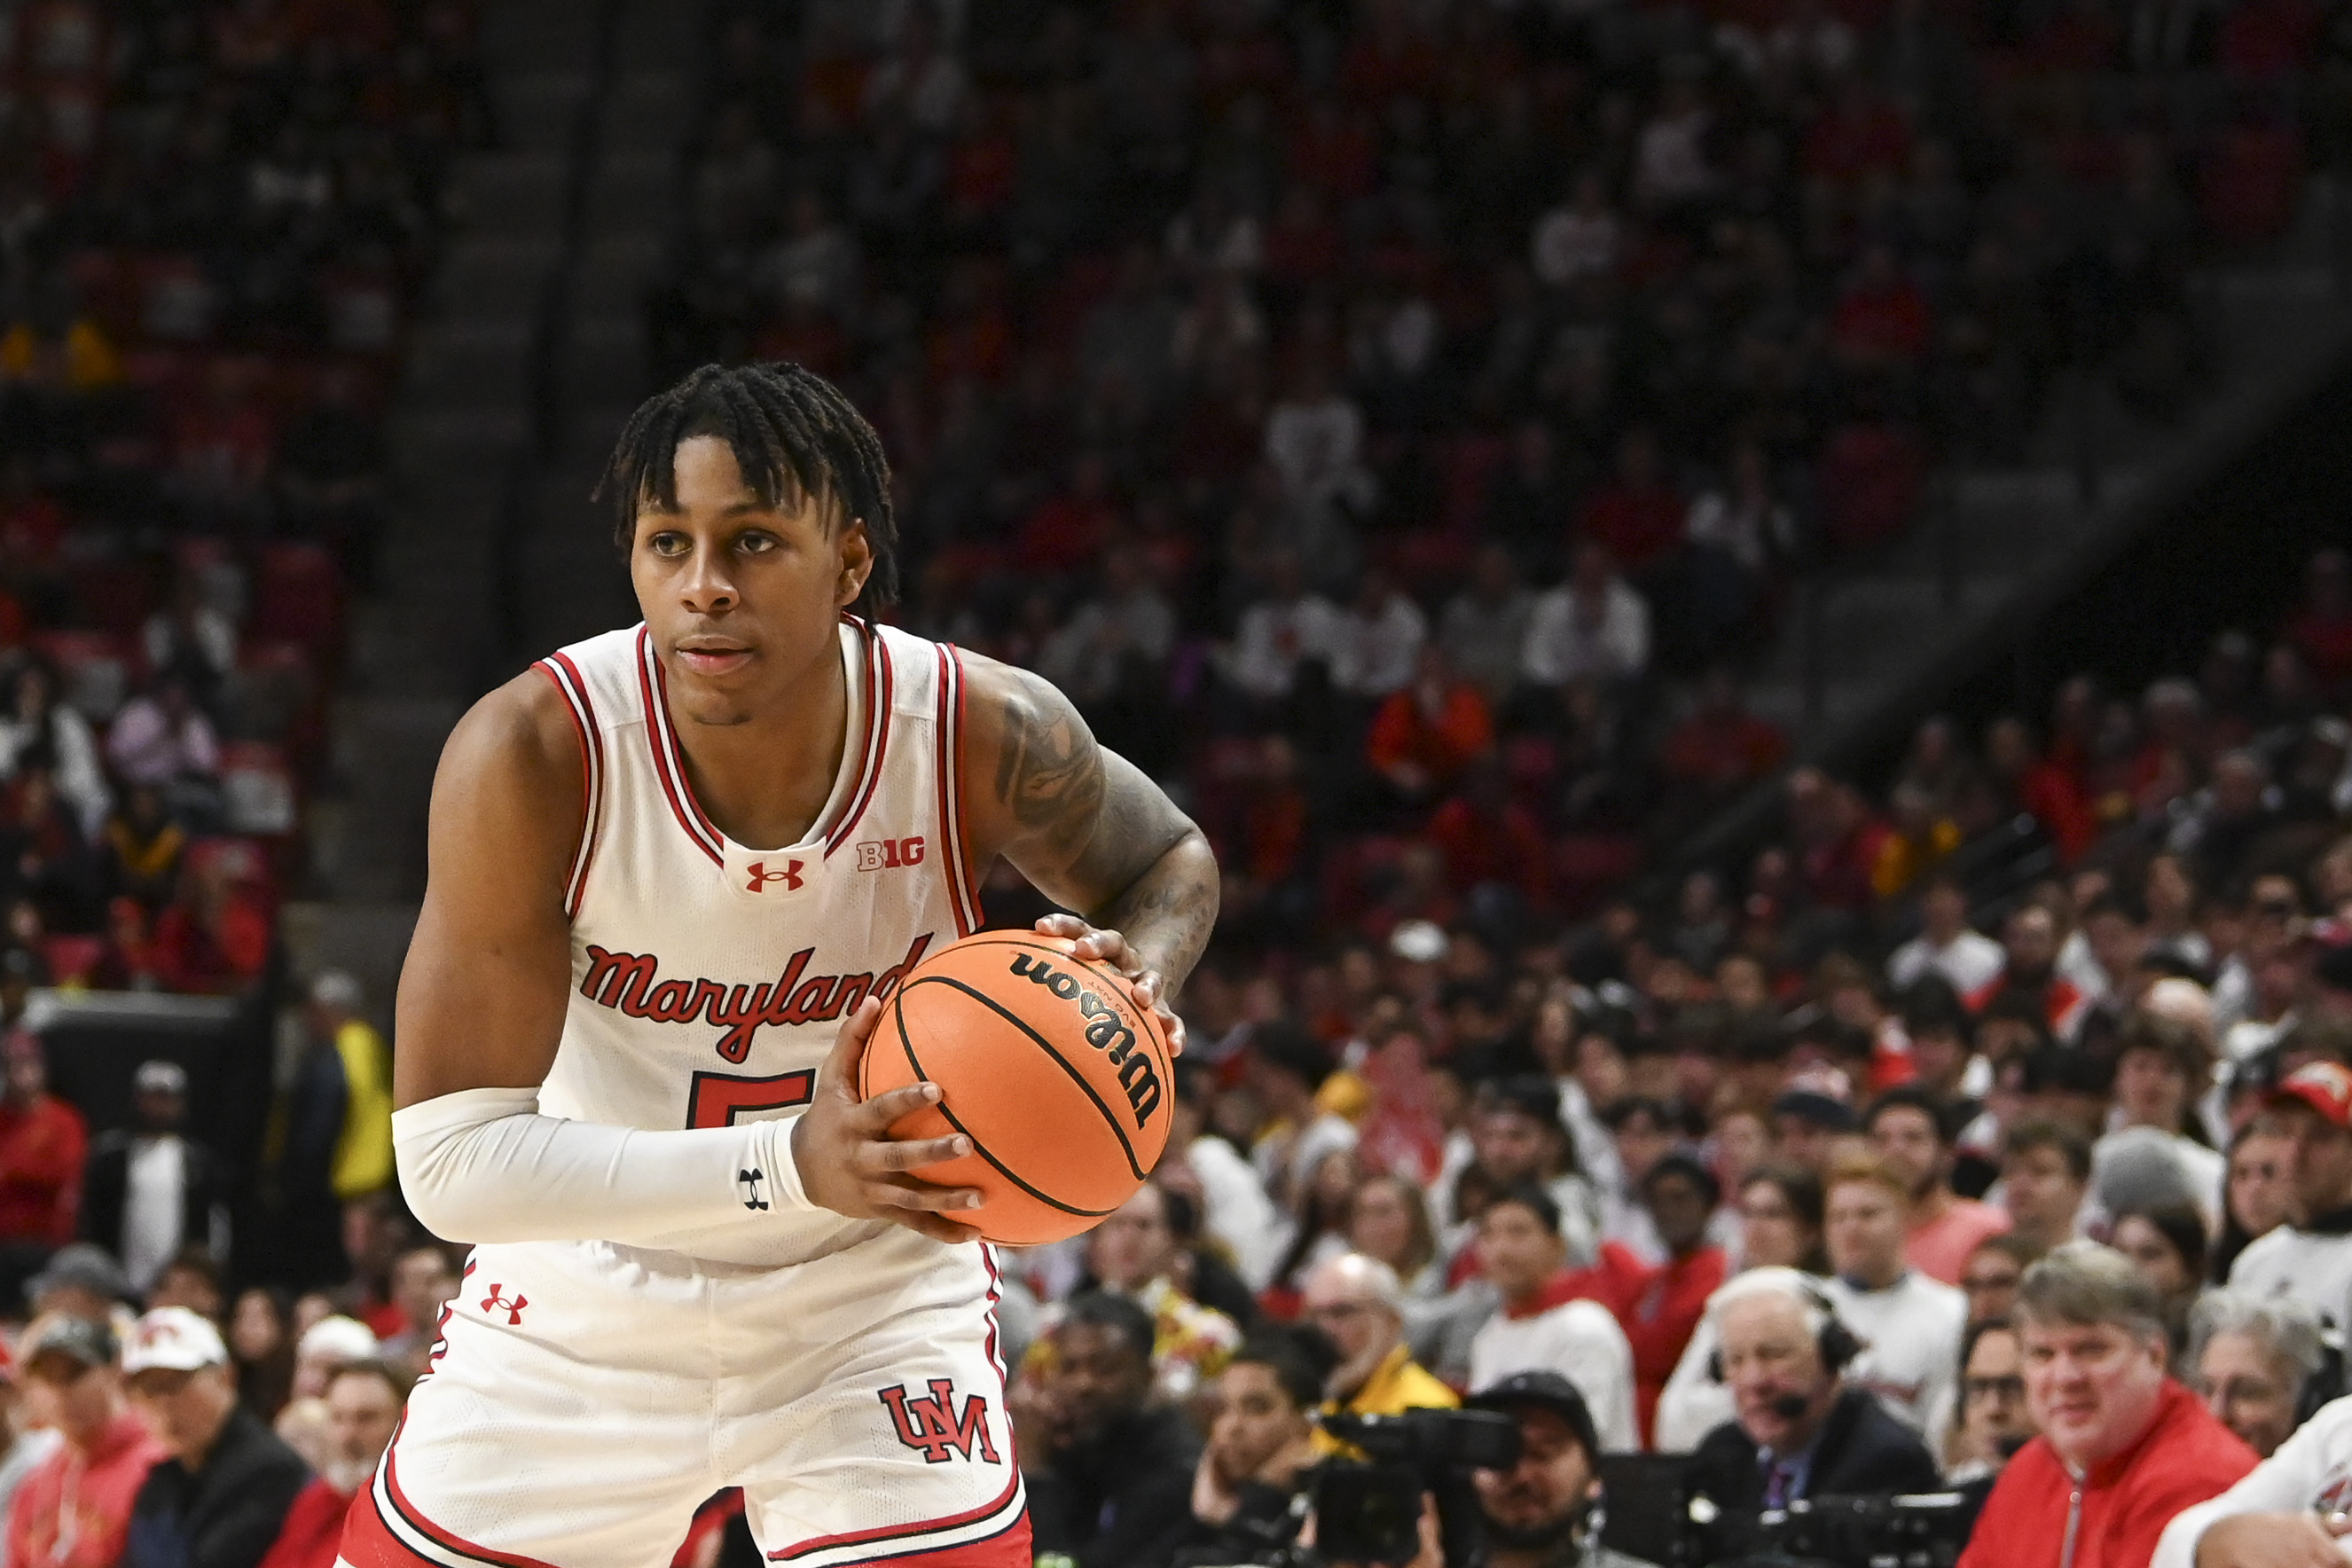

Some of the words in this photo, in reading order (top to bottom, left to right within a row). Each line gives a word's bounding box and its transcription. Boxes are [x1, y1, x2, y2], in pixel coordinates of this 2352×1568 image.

[1087, 981, 1112, 1001] NXT
[1115, 1003, 1136, 1029] EVO
[1009, 952, 1161, 1130] Wilson
